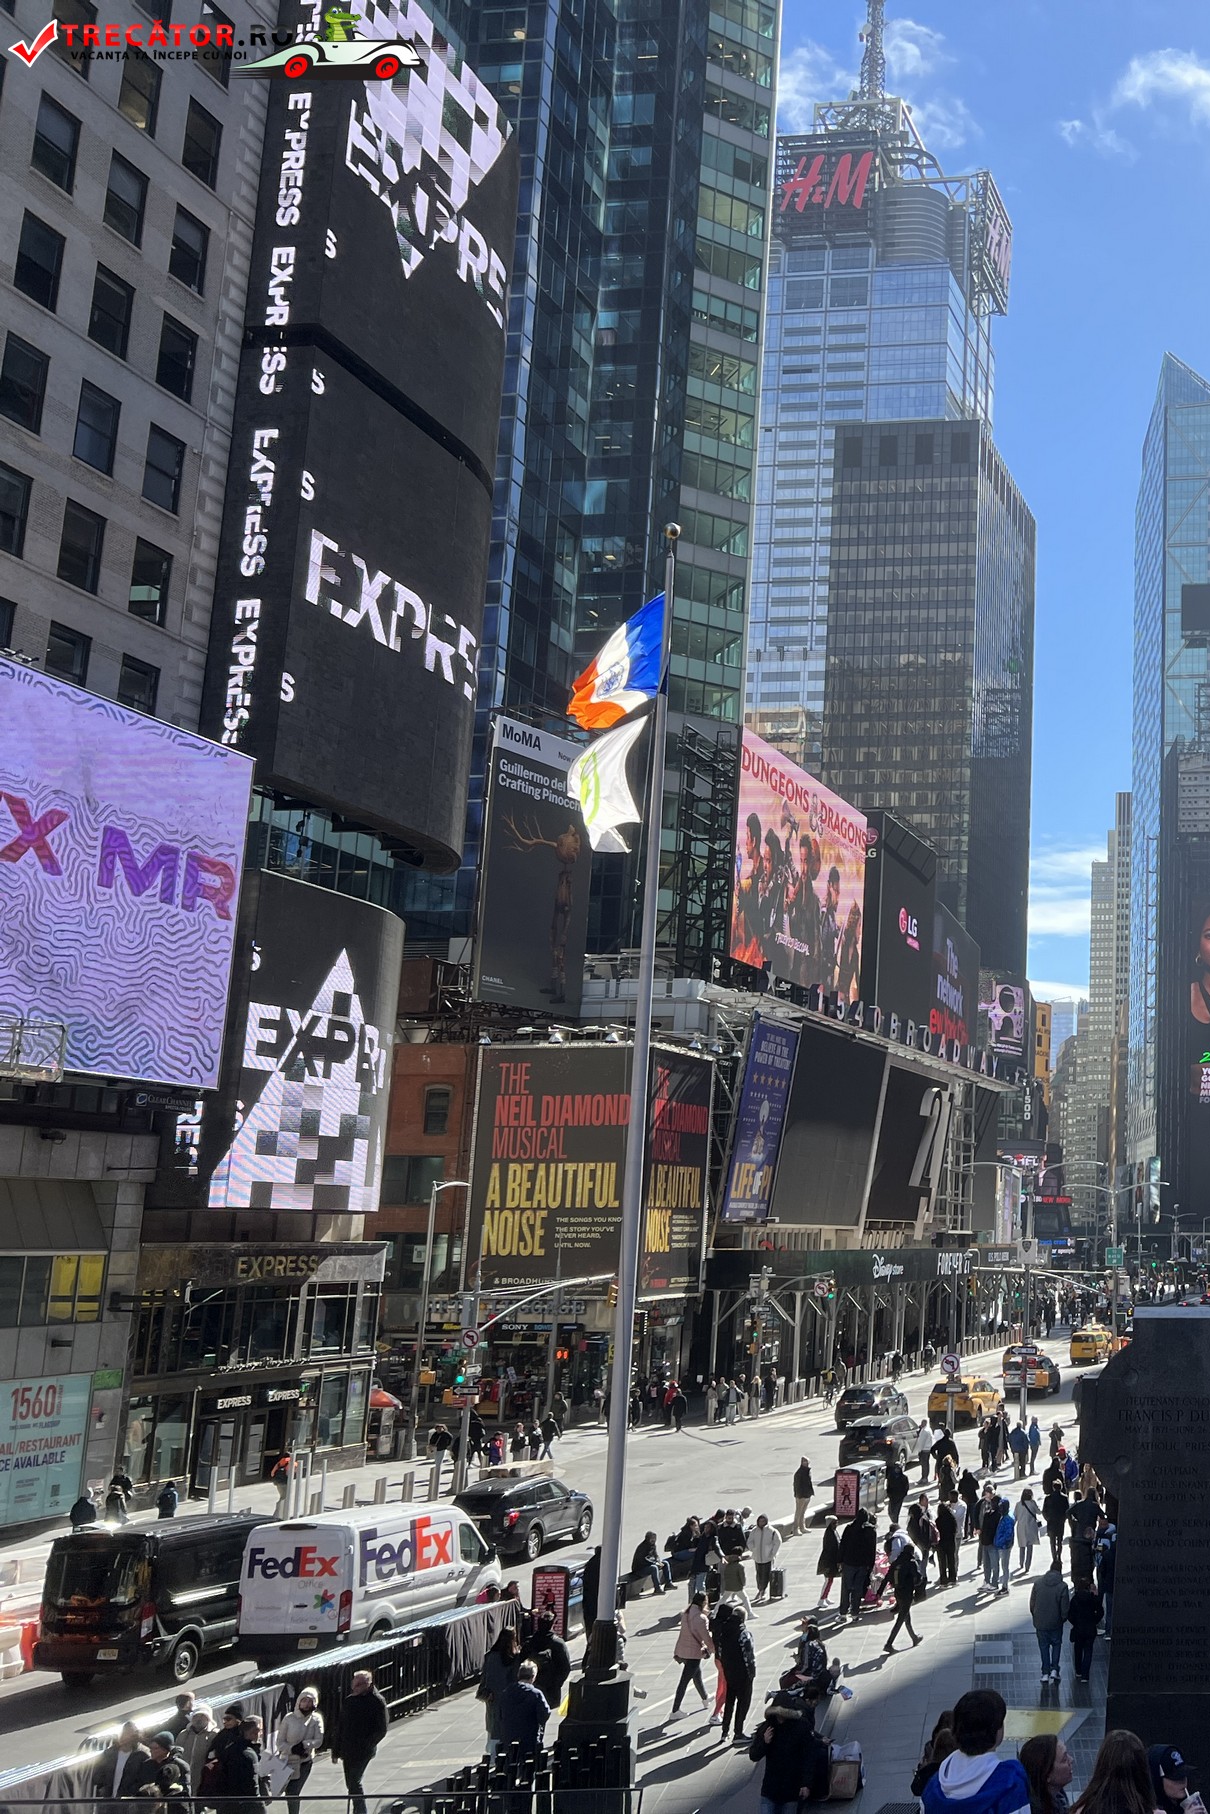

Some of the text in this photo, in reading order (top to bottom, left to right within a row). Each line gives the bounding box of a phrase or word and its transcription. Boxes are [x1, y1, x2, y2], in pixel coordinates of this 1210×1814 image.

[780, 151, 874, 213] H&M
[502, 723, 542, 751] MoMA
[500, 759, 566, 792] Guillermo del
[498, 773, 582, 812] Crafting Pinocch
[742, 744, 809, 813] DUNGEONS
[820, 799, 867, 851] DRAGONS
[907, 915, 918, 938] LG
[889, 1012, 998, 1078] BROADWAY
[499, 1062, 531, 1095] THE
[494, 1094, 631, 1127] NEIL DIAMOND
[672, 1102, 708, 1135] DIAMOND
[1023, 1087, 1032, 1121] 1500
[491, 1126, 568, 1159] MUSICAL
[486, 1162, 619, 1210] A BEAUTIFUL
[656, 1164, 701, 1208] BEAUTIFUL
[730, 1162, 757, 1200] LIFE
[759, 1165, 773, 1200] PI
[481, 1210, 548, 1256] NOISE
[645, 1209, 672, 1253] NOISE
[237, 1255, 319, 1278] EXPRESS
[872, 1254, 904, 1283] Disney store
[11, 1384, 57, 1421] 1560
[217, 1395, 252, 1409] EXPRESS
[268, 1389, 300, 1402] EXPRESS
[1119, 1409, 1173, 1422] FRANCIS
[13, 1451, 66, 1470] AVAILABLE
[1132, 1442, 1178, 1451] CATHOLIC
[1143, 1519, 1162, 1528] LIFE
[1166, 1519, 1178, 1528] OF
[247, 1546, 340, 1579] FedEx
[359, 1516, 452, 1587] FedEx
[298, 1580, 324, 1589] Office
